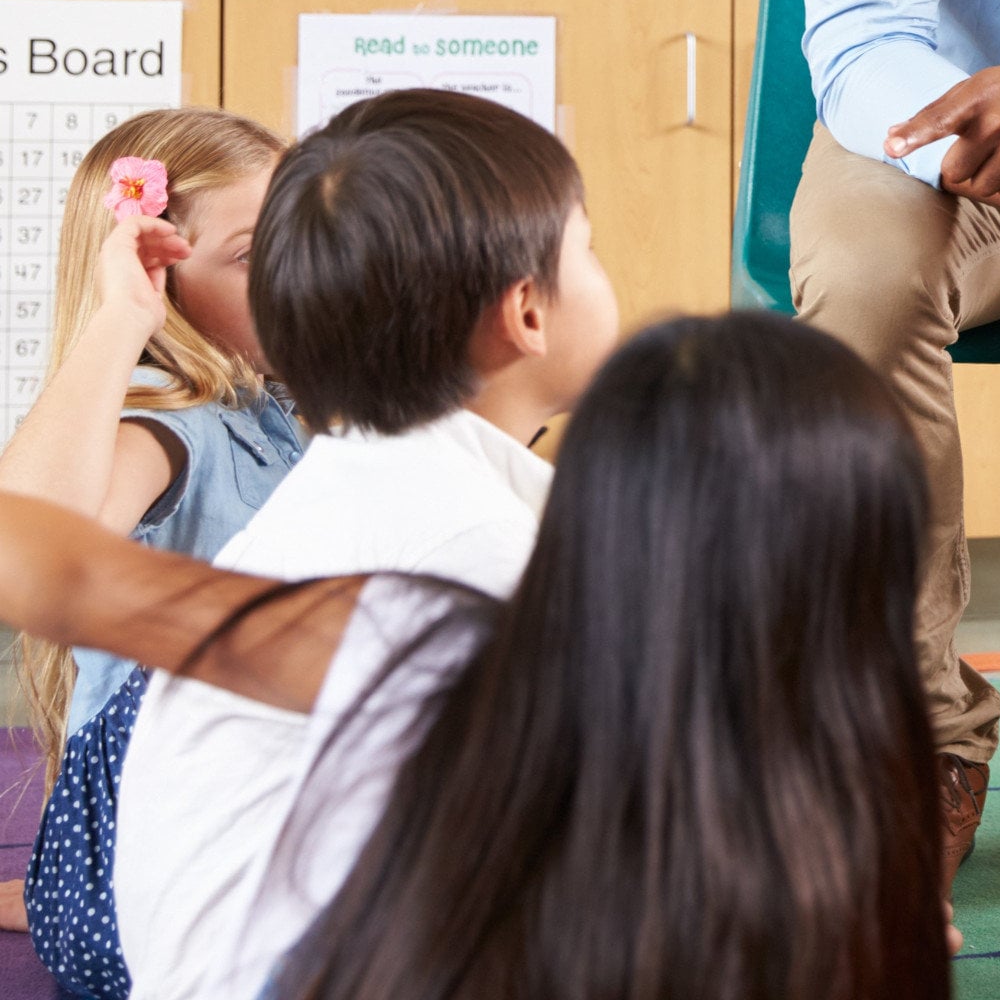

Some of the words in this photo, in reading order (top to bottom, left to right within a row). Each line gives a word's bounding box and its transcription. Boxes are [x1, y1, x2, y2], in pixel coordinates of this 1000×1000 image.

[354, 36, 405, 56] Read
[435, 37, 538, 57] someone
[30, 38, 164, 77] Board
[26, 112, 37, 130] 7
[66, 112, 78, 130] 8
[106, 114, 118, 129] 9
[22, 150, 43, 168] 17
[18, 187, 42, 205] 27
[17, 226, 42, 244] 37
[14, 263, 41, 281] 47
[16, 301, 41, 319] 57
[15, 338, 41, 357] 67
[15, 376, 39, 394] 77
